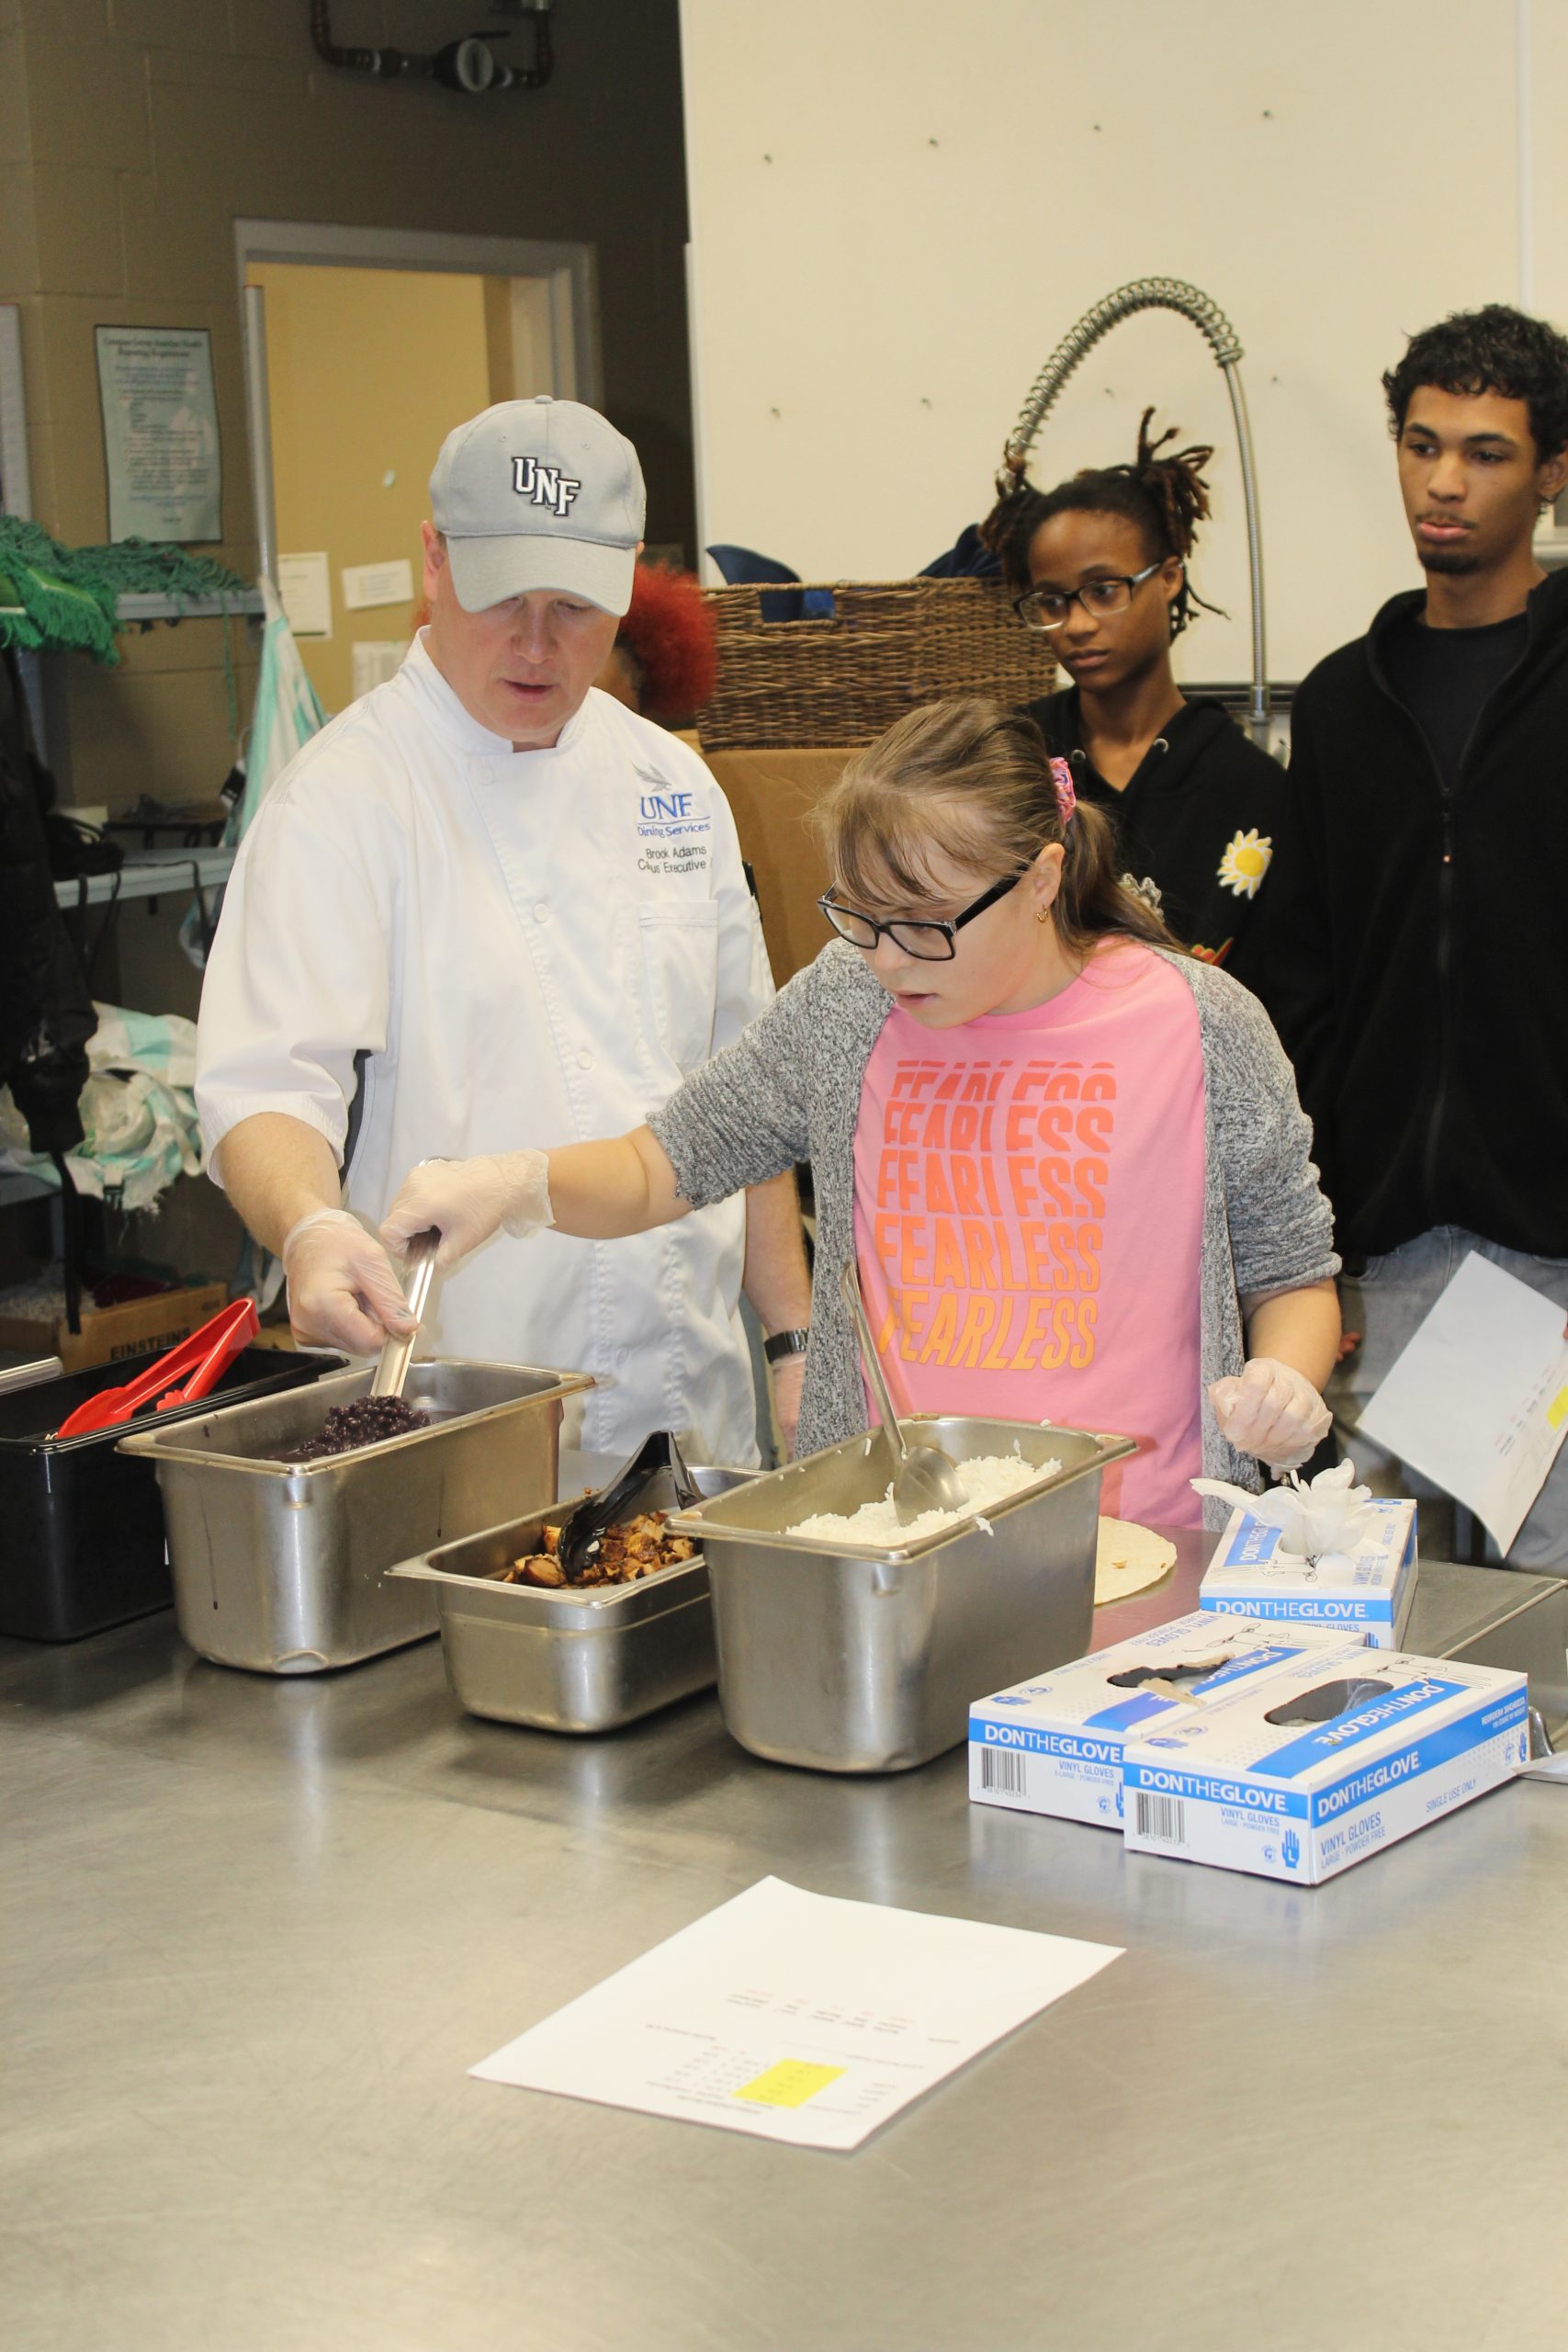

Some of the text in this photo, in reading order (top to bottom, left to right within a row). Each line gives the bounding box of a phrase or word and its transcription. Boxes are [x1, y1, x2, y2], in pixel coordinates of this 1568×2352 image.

[511, 457, 581, 517] UNF
[640, 792, 693, 820] UNF
[665, 821, 712, 837] Services
[646, 845, 707, 860] Brook Adams
[663, 858, 707, 874] Executive
[877, 1148, 1110, 1219] FEARLESS
[874, 1212, 1102, 1293] FEARLESS
[878, 1288, 1099, 1371] FEARLESS
[1216, 1600, 1368, 1618] DONTHEGLOVE
[985, 1724, 1122, 1764] DONTHEGLOVE
[1059, 1760, 1115, 1779] VINYL GLOVES
[1318, 1751, 1420, 1818] DONTHEGLOVE
[1140, 1769, 1287, 1812] DONTHEGLOVE
[1426, 1779, 1478, 1814] SINGLE USE ONLY
[1221, 1807, 1280, 1827] VINYL GLOVES
[1320, 1811, 1382, 1856] VINYL GLOVES
[1288, 1849, 1296, 1861] L
[1321, 1826, 1386, 1870] LARGE POWDER FREE
